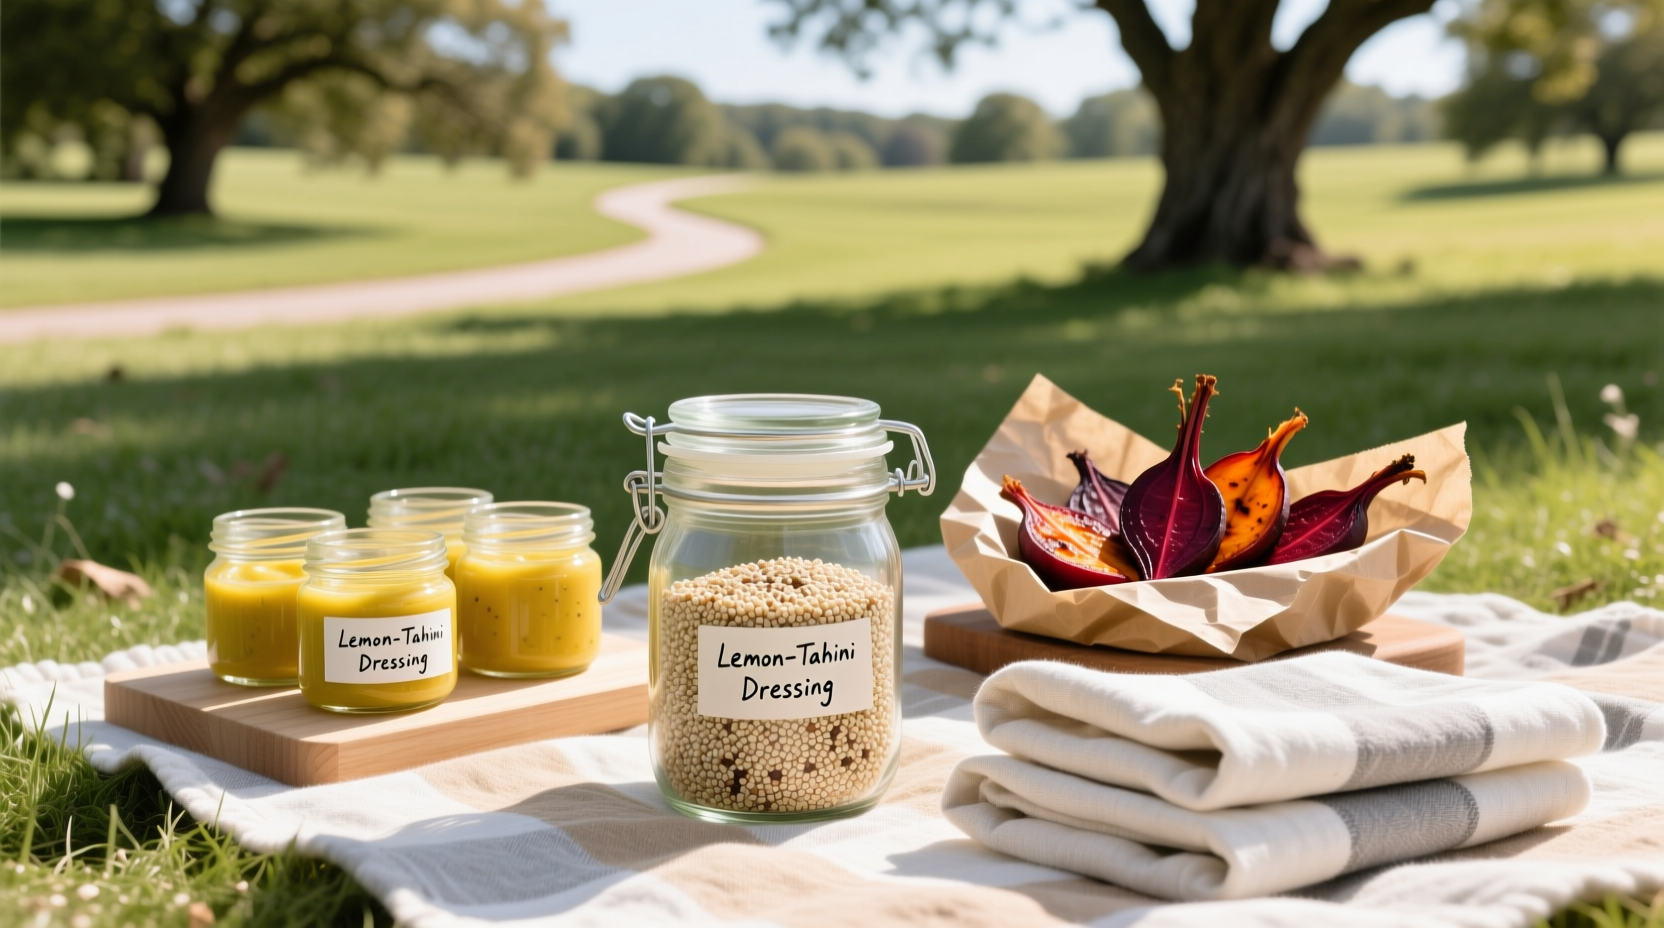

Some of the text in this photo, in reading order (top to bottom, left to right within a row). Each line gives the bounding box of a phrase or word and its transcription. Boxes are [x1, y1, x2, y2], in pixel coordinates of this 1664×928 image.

[338, 624, 443, 648] Lemon-Tahini
[358, 653, 428, 675] Dressing
[717, 641, 855, 668] Lemon-Tahini
[741, 675, 834, 708] Dressing
